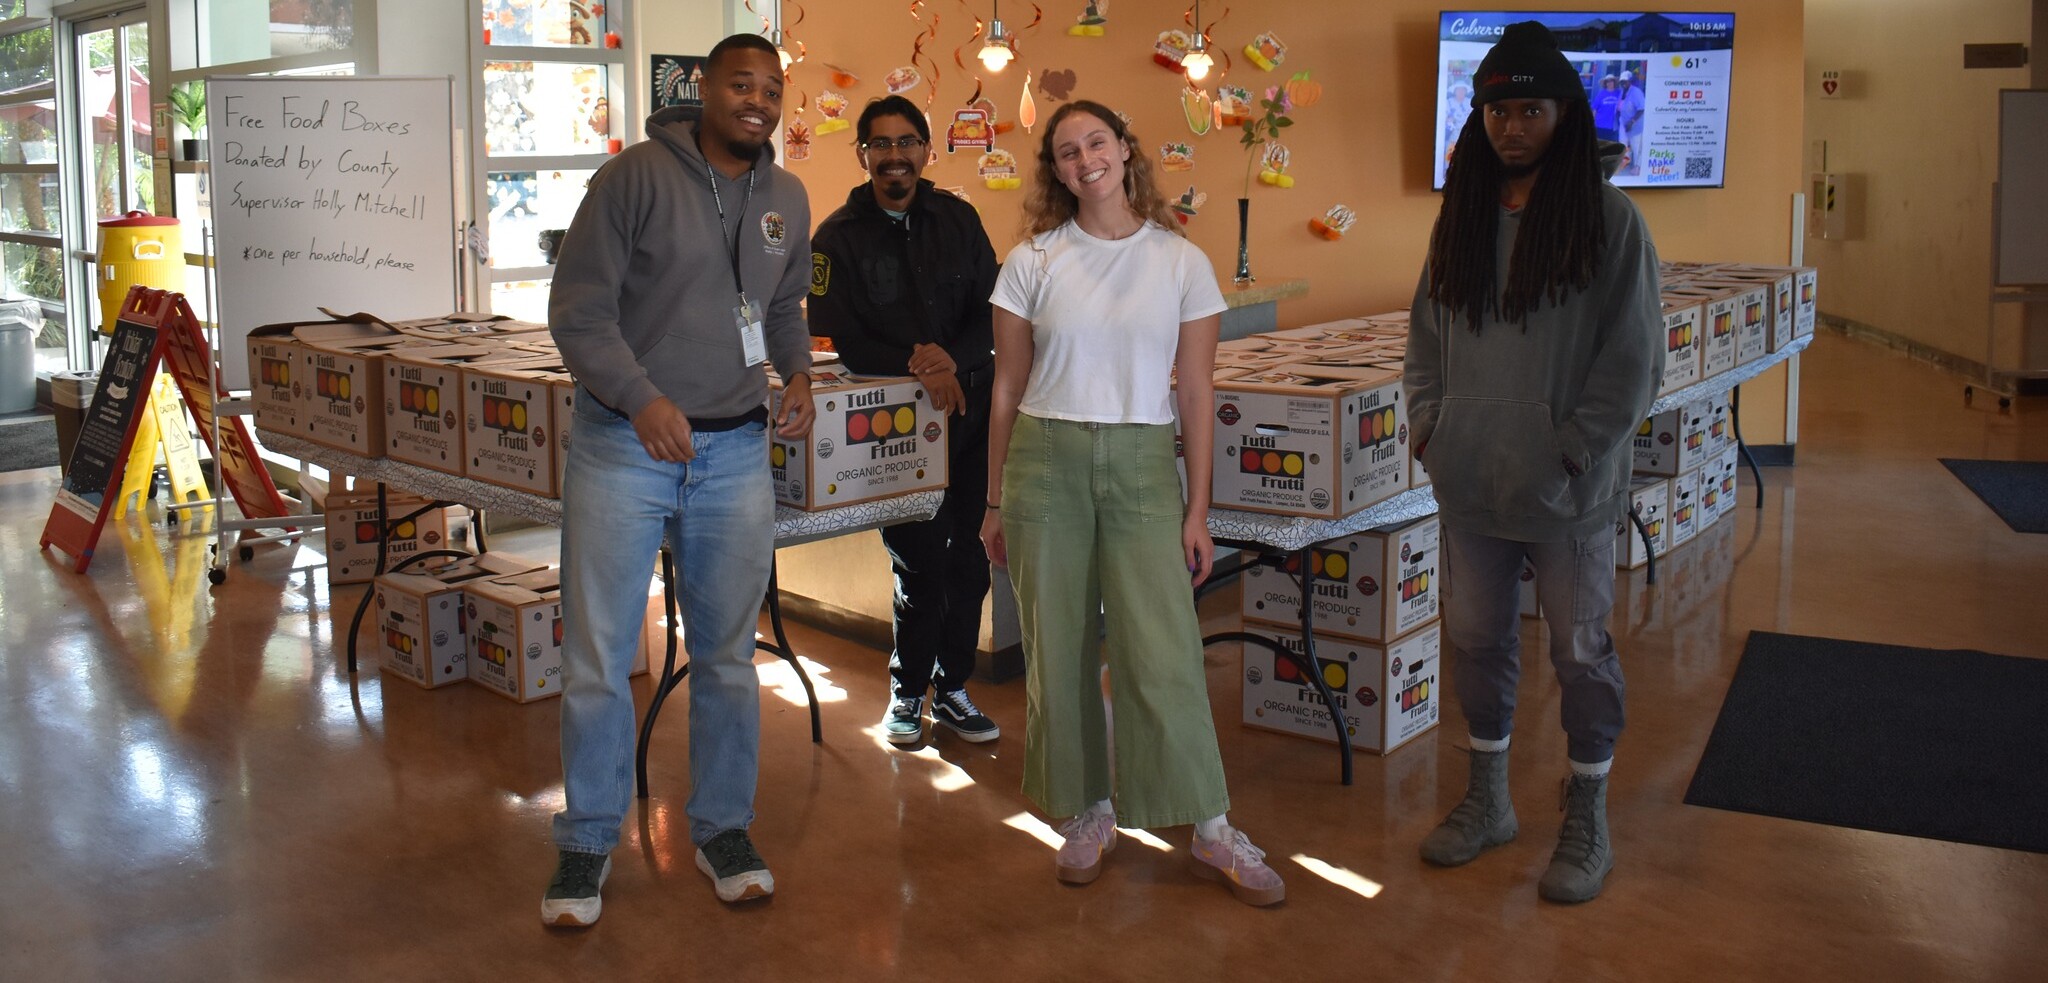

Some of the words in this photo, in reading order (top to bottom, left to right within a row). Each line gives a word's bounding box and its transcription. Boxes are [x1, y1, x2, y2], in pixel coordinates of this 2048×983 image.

[1450, 17, 1493, 35] Culver
[1494, 26, 1505, 35] CI
[1690, 22, 1711, 30] 10:15
[1713, 22, 1726, 30] AM
[1685, 57, 1707, 69] 61°
[1822, 71, 1839, 79] AED
[678, 82, 700, 100] NATI
[225, 96, 265, 129] Free
[282, 96, 330, 129] Food
[341, 100, 411, 136] Boxes
[1648, 156, 1675, 167] Make
[1649, 148, 1676, 159] Parks
[225, 141, 288, 168] Donated
[298, 145, 322, 180] by
[337, 149, 399, 189] County
[1652, 166, 1671, 175] Life
[1647, 171, 1680, 183] Better!
[230, 181, 305, 218] Supervisor
[313, 188, 346, 219] Holly
[354, 191, 425, 220] Mitchell
[282, 250, 301, 266] per
[308, 237, 370, 270] household,
[374, 252, 415, 272] please
[316, 353, 335, 368] Tutti
[400, 366, 422, 382] Tutti
[482, 378, 506, 396] Tutti
[844, 388, 886, 408] Tutti
[1358, 390, 1380, 411] Tutti
[159, 403, 178, 415] CAUTION
[328, 400, 352, 418] Frutti
[414, 416, 440, 434] Frutti
[498, 433, 528, 452] Frutti
[871, 438, 917, 460] Frutti
[1240, 434, 1276, 448] Tutti
[478, 447, 505, 464] ORGANIC
[506, 454, 537, 470] PRODUCE
[1372, 441, 1395, 464] Frutti
[836, 465, 882, 482] ORGANIC
[884, 458, 928, 474] PRODUCE
[1354, 469, 1378, 488] ORGANIC
[1378, 460, 1400, 478] PRODUCE
[868, 477, 884, 486] SINCE
[1261, 476, 1305, 491] Frutti
[1242, 489, 1272, 499] ORGANIC
[1272, 492, 1303, 502] PRODUCE
[355, 508, 390, 520] Tuti
[387, 541, 418, 552] rutti
[348, 558, 376, 566] ORGAN
[1404, 564, 1418, 578] Tutti
[1312, 582, 1348, 600] rutti
[1264, 592, 1301, 606] ORGAN
[1314, 600, 1361, 616] PRODUCE
[1410, 592, 1428, 610] Frutti
[1275, 634, 1316, 655] Tuti
[1402, 673, 1418, 690] Tutti
[1298, 688, 1348, 710] Fruti
[1264, 700, 1310, 717] ORGANIC
[1312, 710, 1360, 726] PROCE
[1410, 701, 1428, 719] Frutti
